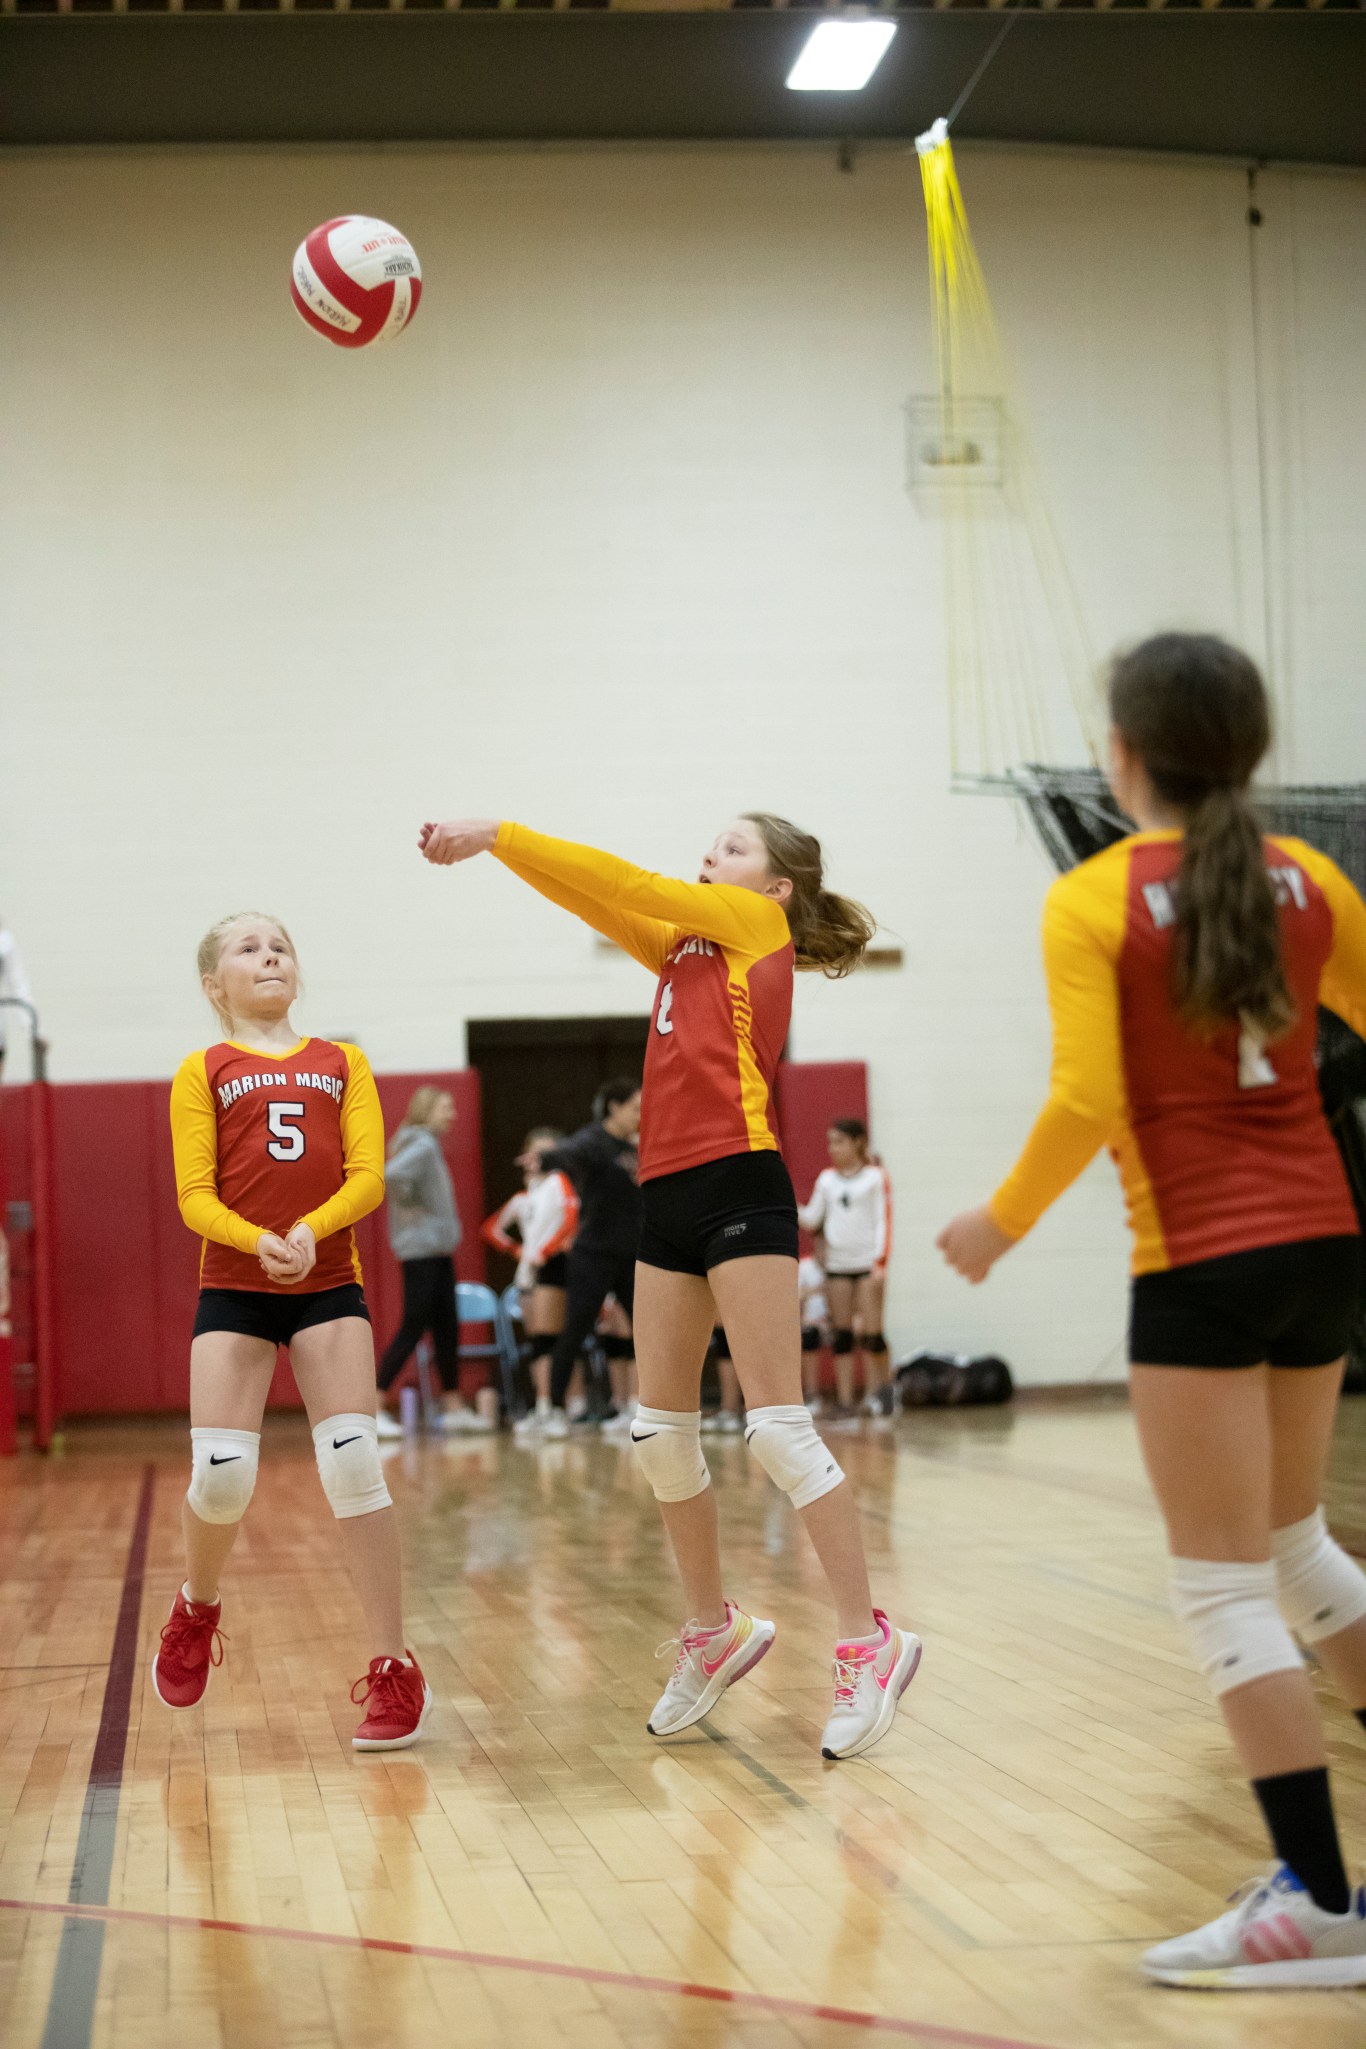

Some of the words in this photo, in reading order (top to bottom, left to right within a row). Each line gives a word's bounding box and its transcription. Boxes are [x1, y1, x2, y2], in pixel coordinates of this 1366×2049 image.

[362, 239, 381, 253] LITE
[385, 261, 414, 273] TACHIKARA
[217, 1072, 288, 1110] MARION
[294, 1072, 344, 1105] MAGIC
[266, 1101, 306, 1162] 5
